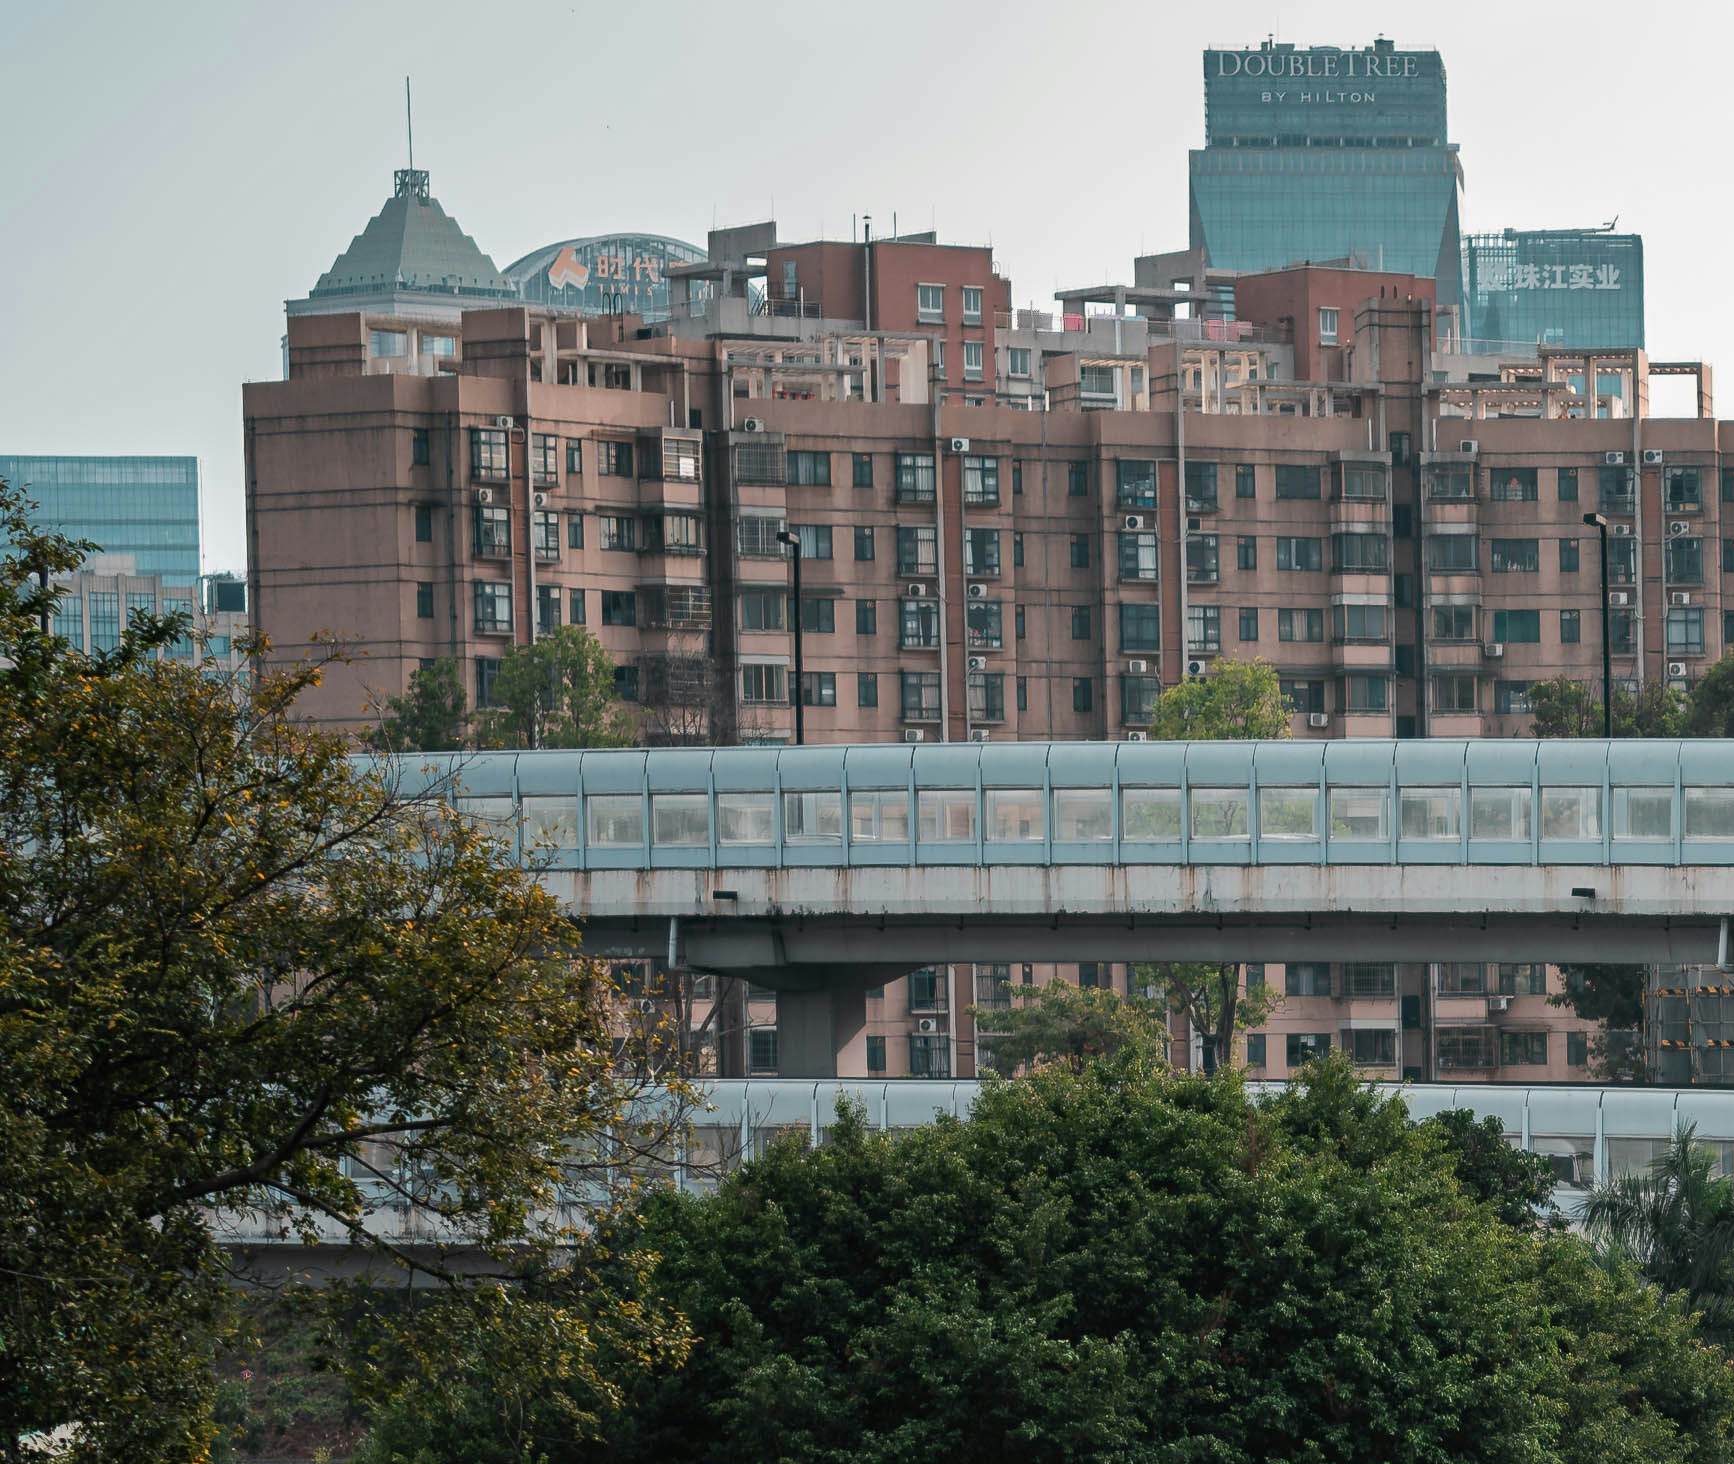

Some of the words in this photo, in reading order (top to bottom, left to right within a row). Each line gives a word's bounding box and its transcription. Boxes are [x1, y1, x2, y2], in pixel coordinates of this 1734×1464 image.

[1217, 52, 1420, 77] DOUBLETREE
[1261, 91, 1287, 102] BY
[1301, 91, 1376, 103] HILTON
[596, 255, 690, 283] 时代
[1514, 263, 1622, 290] 珠江实业
